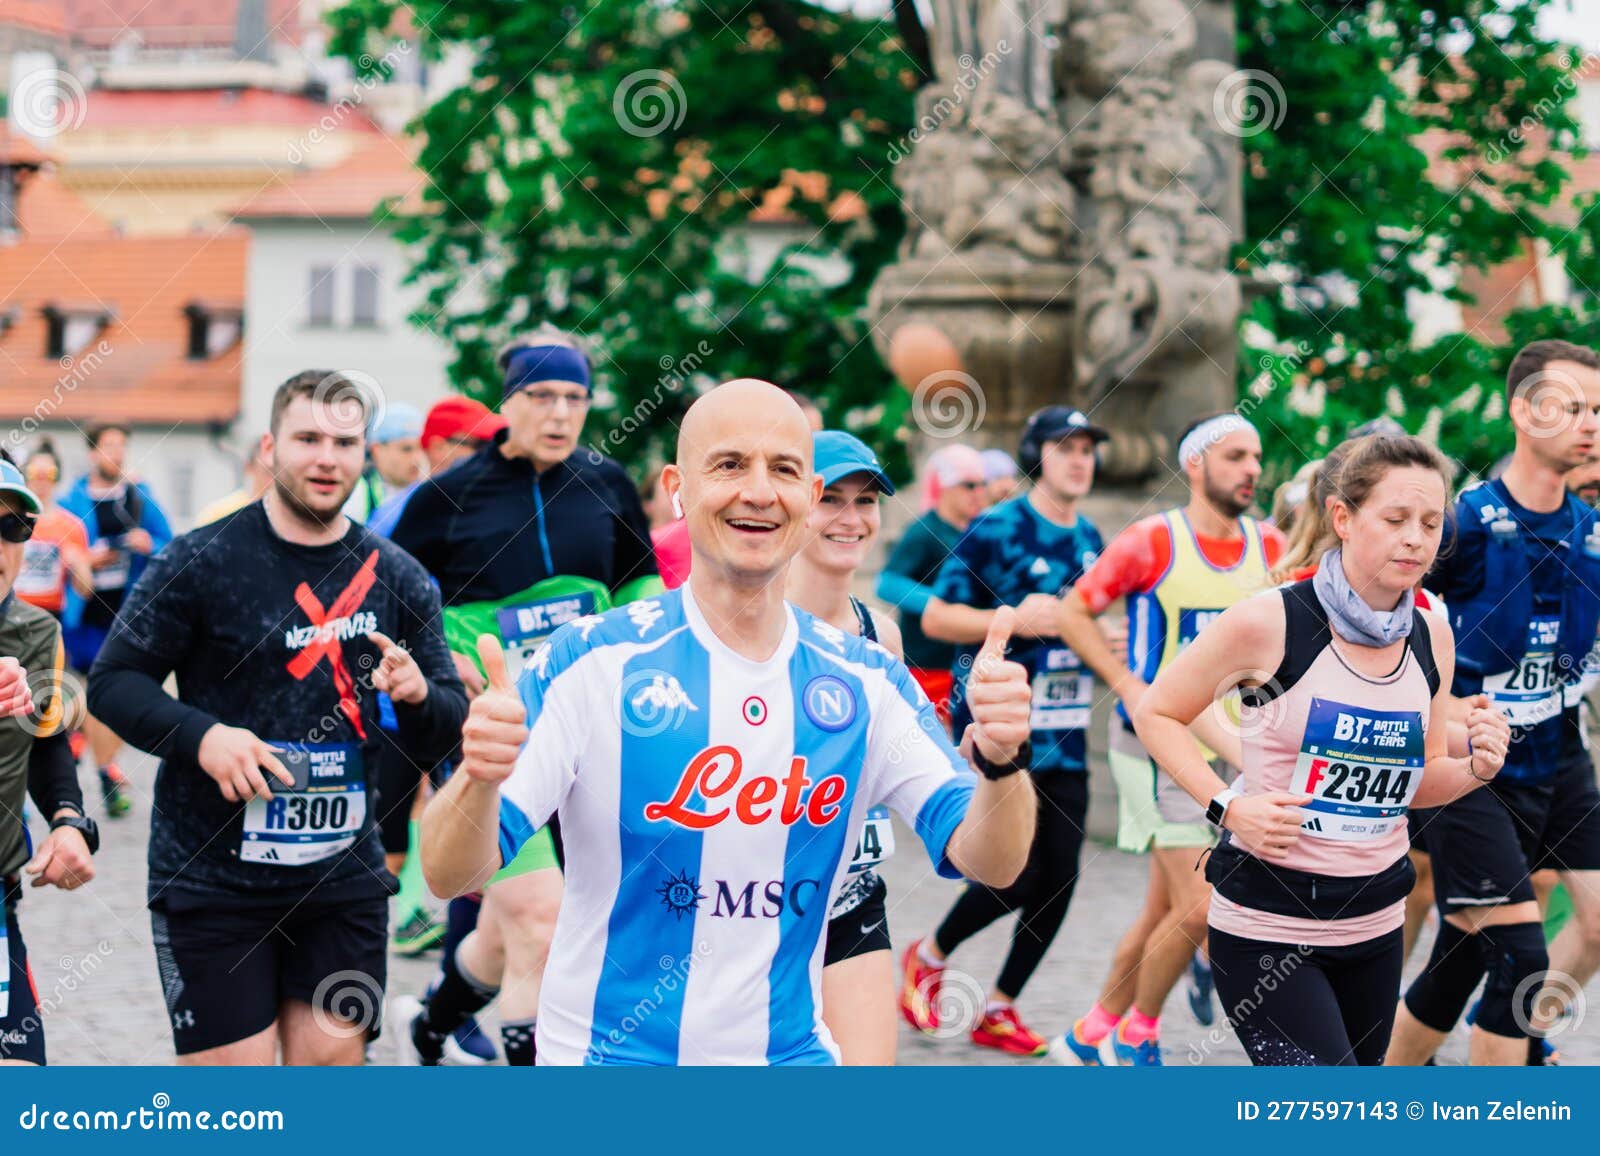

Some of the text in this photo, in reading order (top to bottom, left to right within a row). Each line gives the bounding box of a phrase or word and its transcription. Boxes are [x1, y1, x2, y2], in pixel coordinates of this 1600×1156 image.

[818, 689, 842, 717] N
[1373, 720, 1410, 733] BATTLE
[1373, 735, 1407, 748] TEAMS
[310, 751, 346, 763] BATTLE
[312, 765, 344, 777] TEAMS
[644, 744, 846, 829] Lete
[1305, 758, 1412, 804] F2344
[265, 795, 348, 831] R300
[710, 879, 820, 919] MSC
